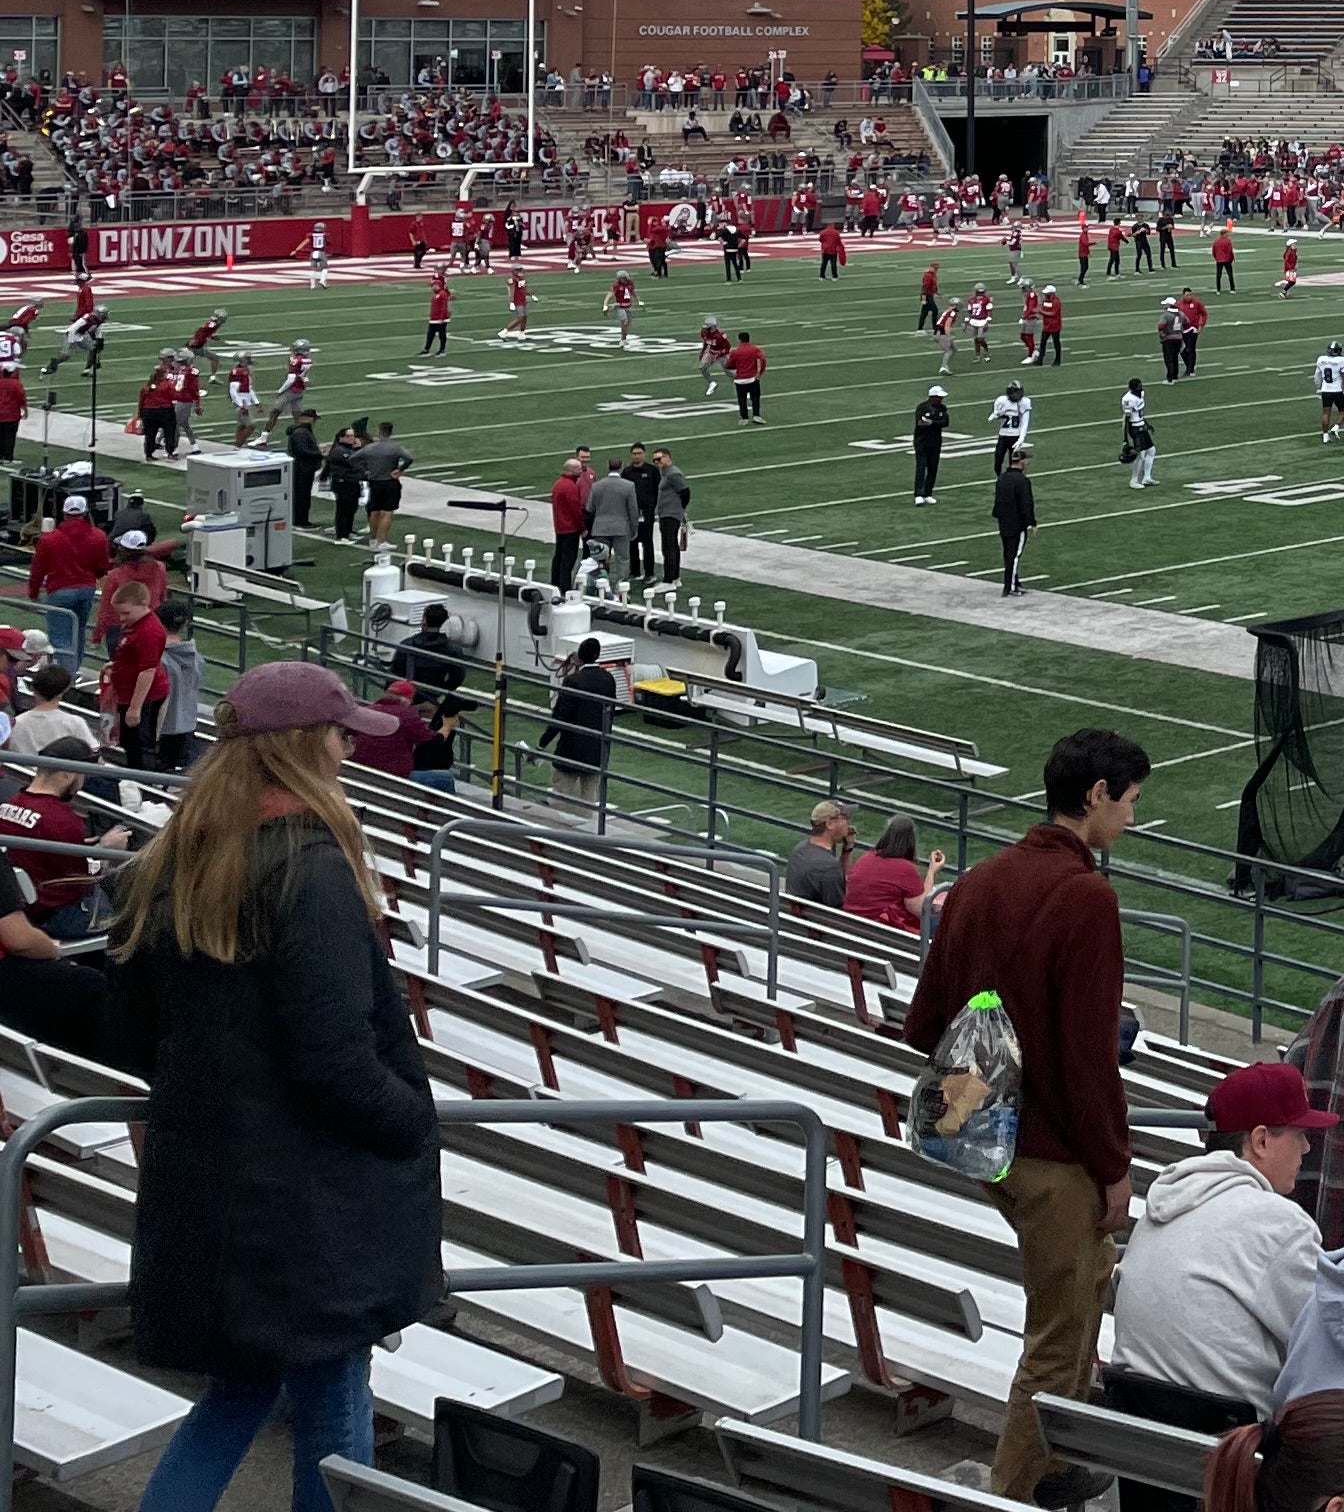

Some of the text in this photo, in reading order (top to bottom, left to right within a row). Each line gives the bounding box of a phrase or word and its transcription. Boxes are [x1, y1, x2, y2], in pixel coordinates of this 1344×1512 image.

[639, 25, 809, 36] COUGAR FOOTBALL COMPLEX
[10, 231, 45, 243] Gesa
[10, 241, 54, 253] Credit
[98, 224, 252, 263] CRIMZONE
[10, 252, 49, 265] Union
